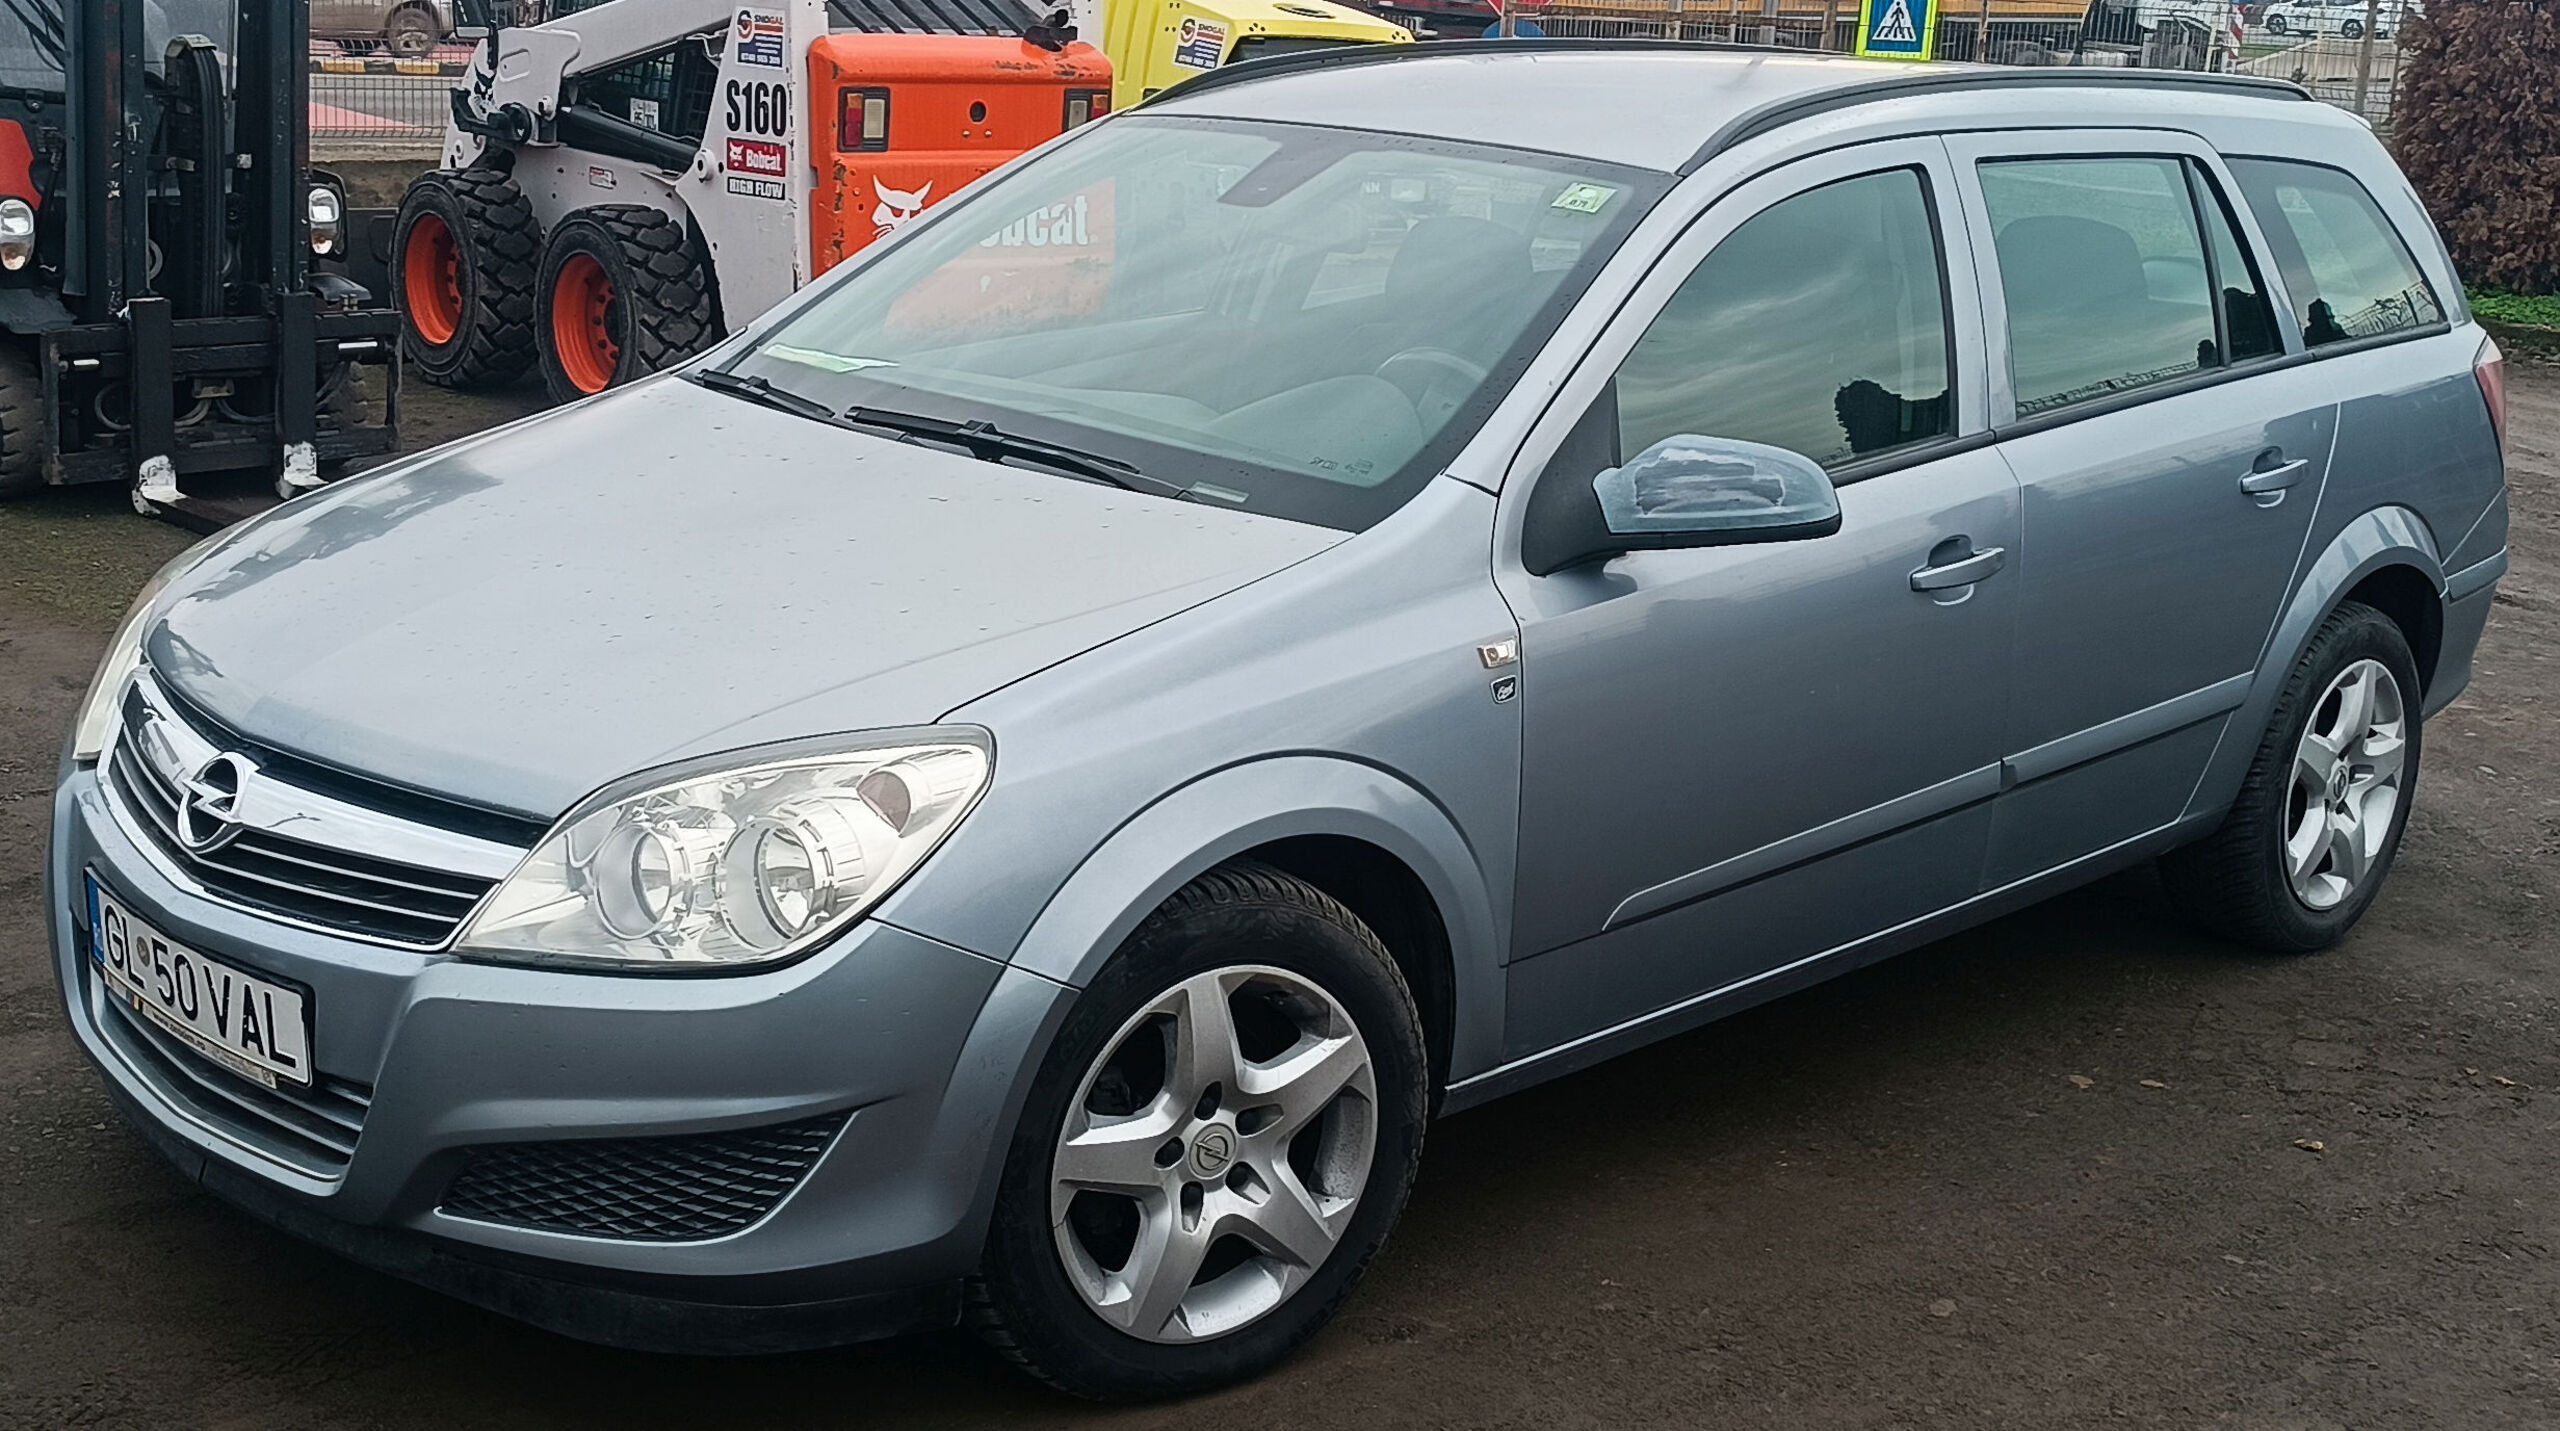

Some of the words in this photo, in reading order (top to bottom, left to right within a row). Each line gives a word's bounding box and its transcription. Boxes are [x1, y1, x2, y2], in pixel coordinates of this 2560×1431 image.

[726, 79, 786, 137] S160
[746, 149, 782, 171] Bobcat
[729, 178, 754, 194] HIGH
[755, 182, 783, 198] FLOW
[104, 904, 145, 989] GL
[151, 936, 198, 1021] 50
[202, 965, 296, 1069] VAL
